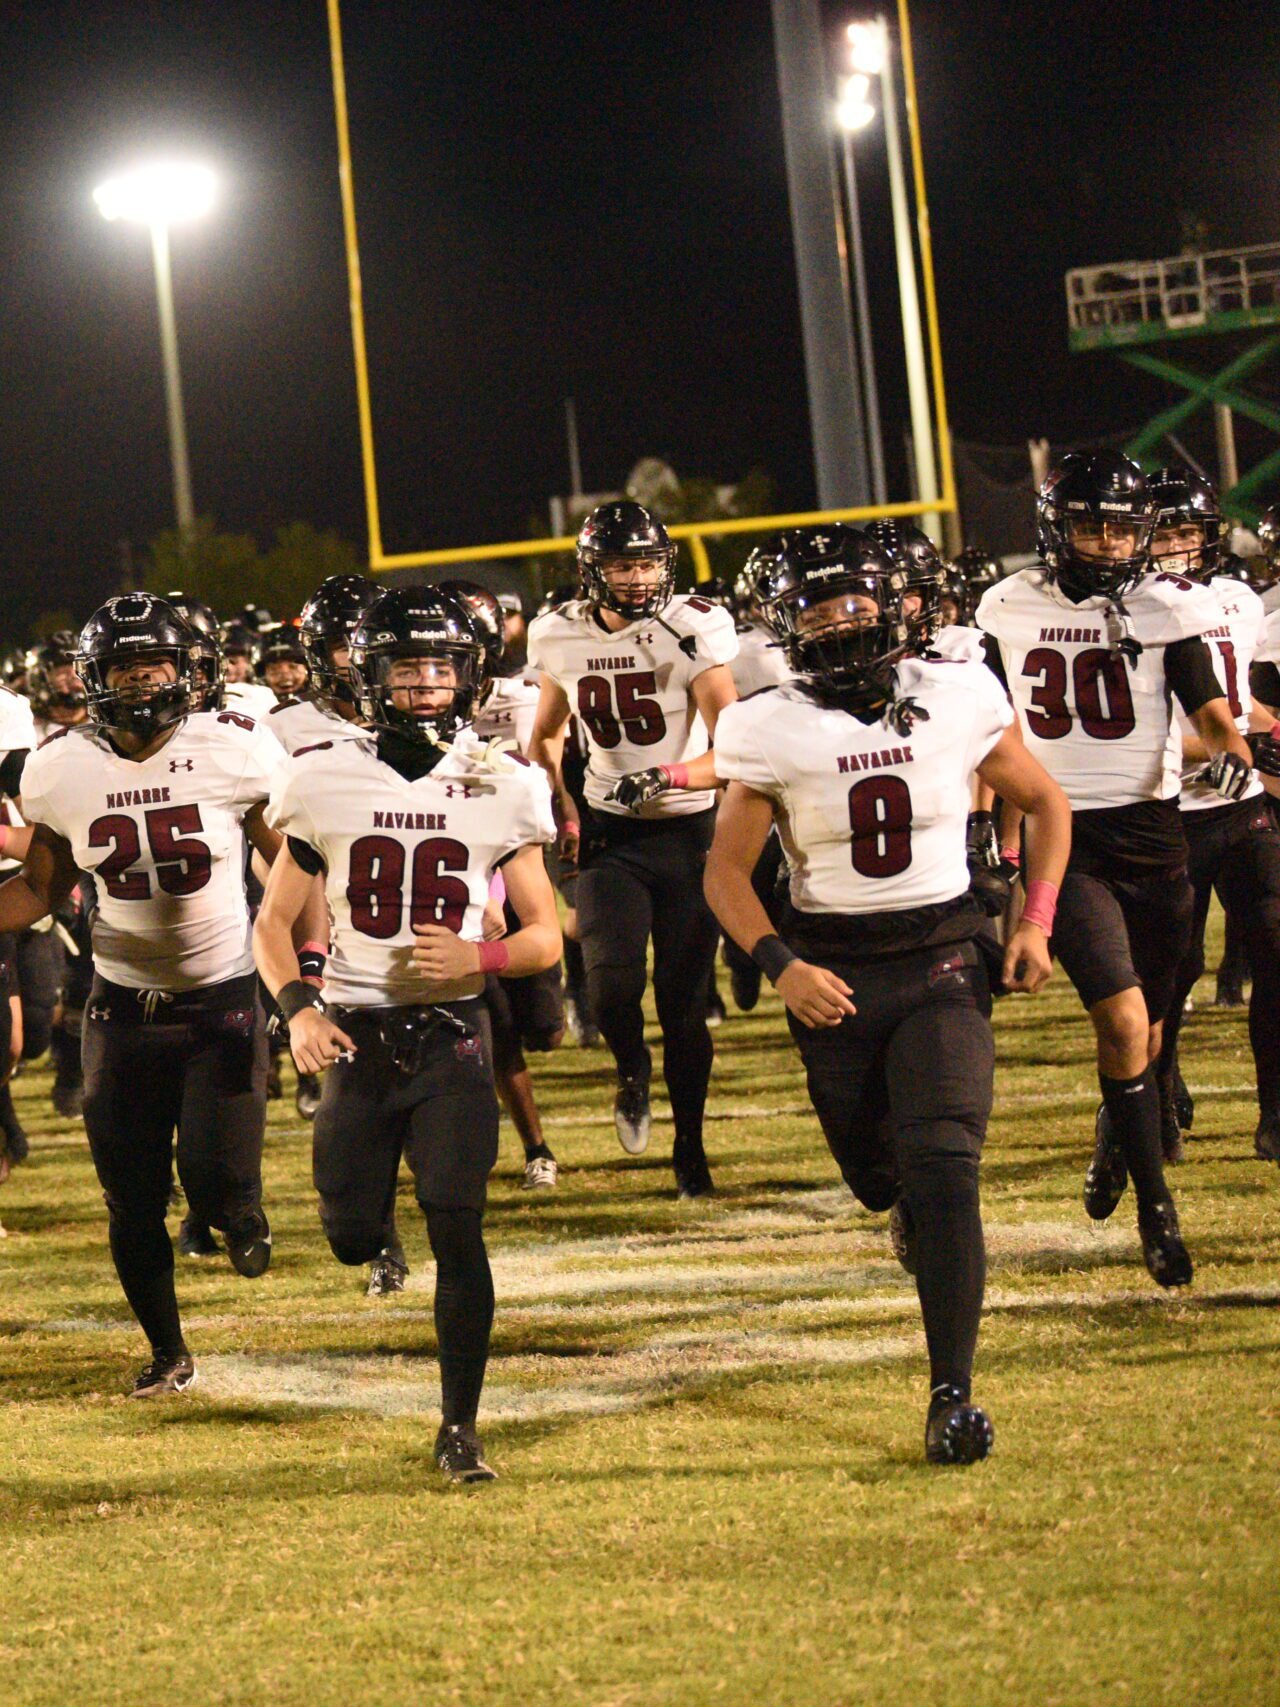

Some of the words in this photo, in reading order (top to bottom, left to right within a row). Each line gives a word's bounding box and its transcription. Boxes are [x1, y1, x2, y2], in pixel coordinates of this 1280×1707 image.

[410, 630, 447, 639] Riddell
[1039, 628, 1101, 643] NAVARRE
[587, 656, 636, 671] NAVARRE
[1021, 648, 1136, 740] 30
[578, 671, 667, 749] 85
[837, 746, 914, 773] NAVARRE
[106, 787, 170, 809] NAVARRE
[373, 811, 447, 830] NAVARRE
[848, 774, 913, 878] 8
[88, 803, 212, 900] 25
[346, 834, 470, 939] 86
